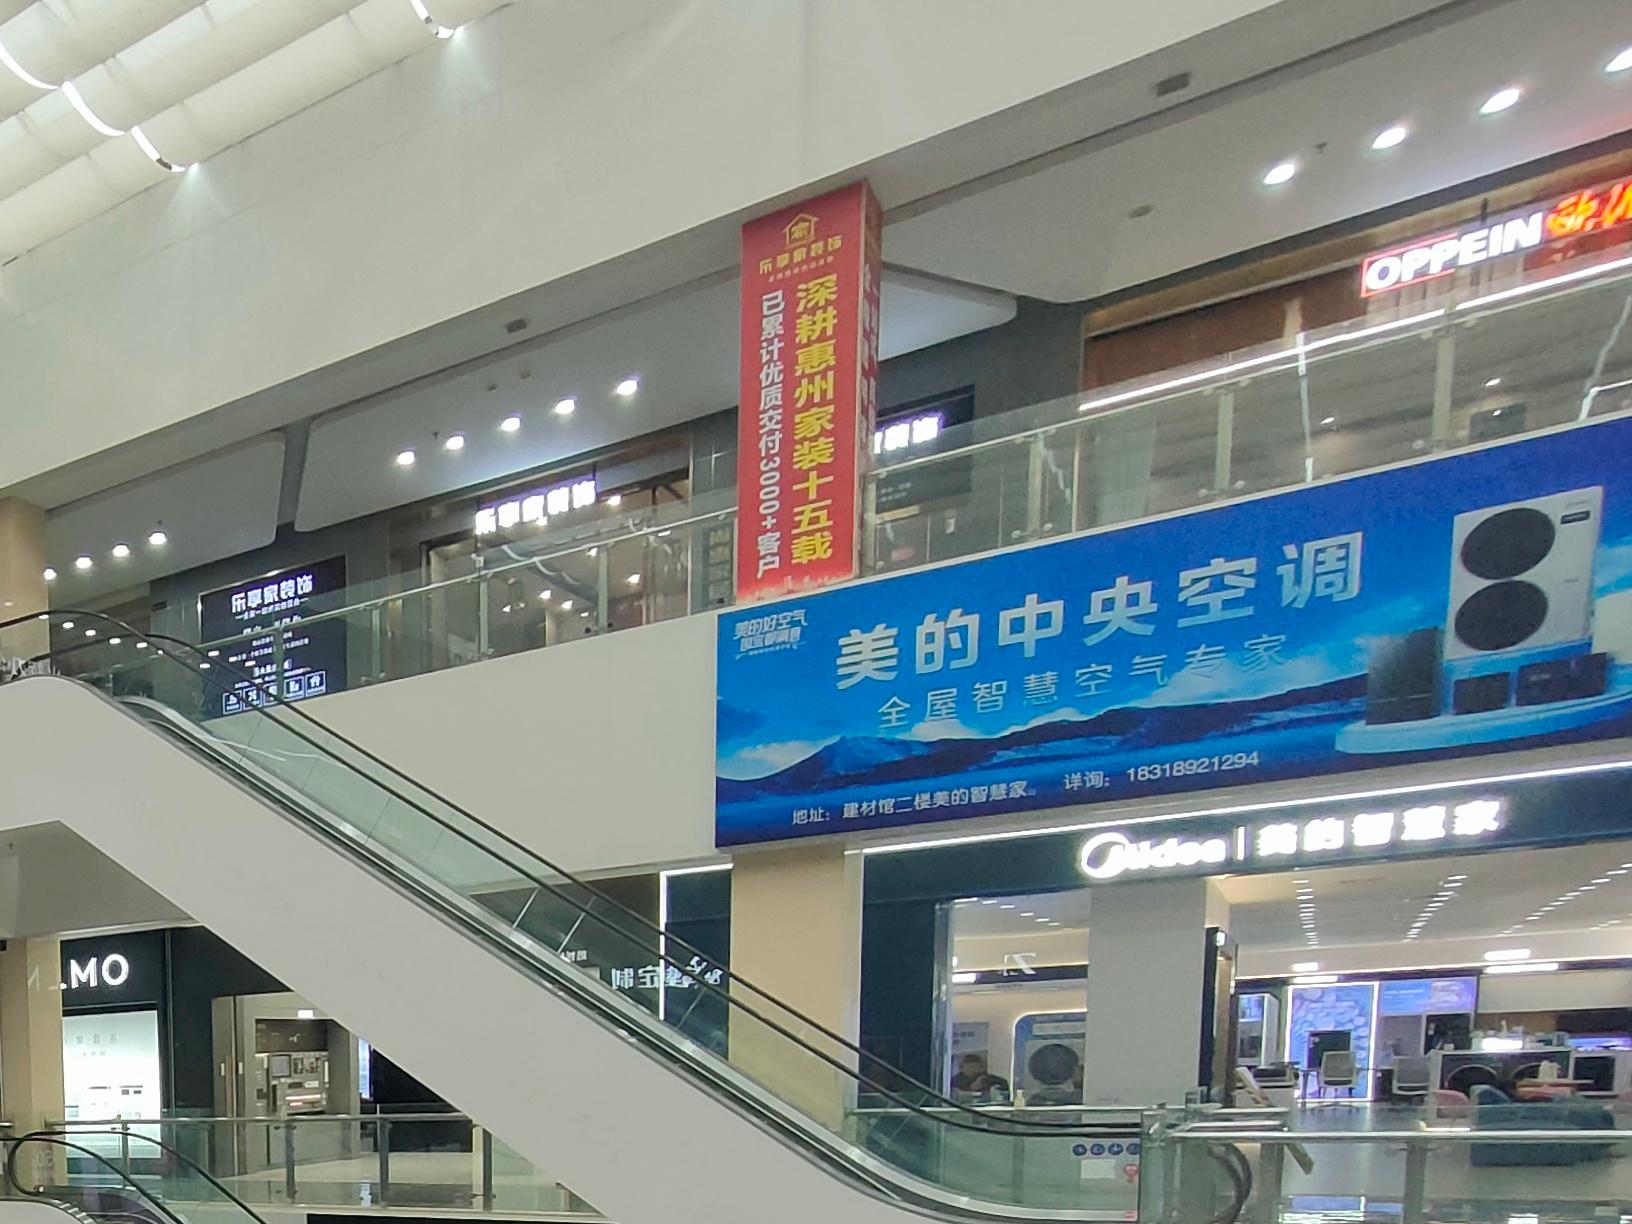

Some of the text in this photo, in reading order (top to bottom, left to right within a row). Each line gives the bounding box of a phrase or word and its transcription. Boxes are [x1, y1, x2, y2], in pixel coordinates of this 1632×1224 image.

[1366, 211, 1543, 291] OPPEIN
[791, 274, 838, 565] 深耕惠州家装十五载
[835, 532, 1364, 690] 美的中央空调
[877, 634, 1288, 729] 全屋智慧空气专家
[1126, 751, 1260, 783] 18318921294
[68, 953, 129, 989] MO
